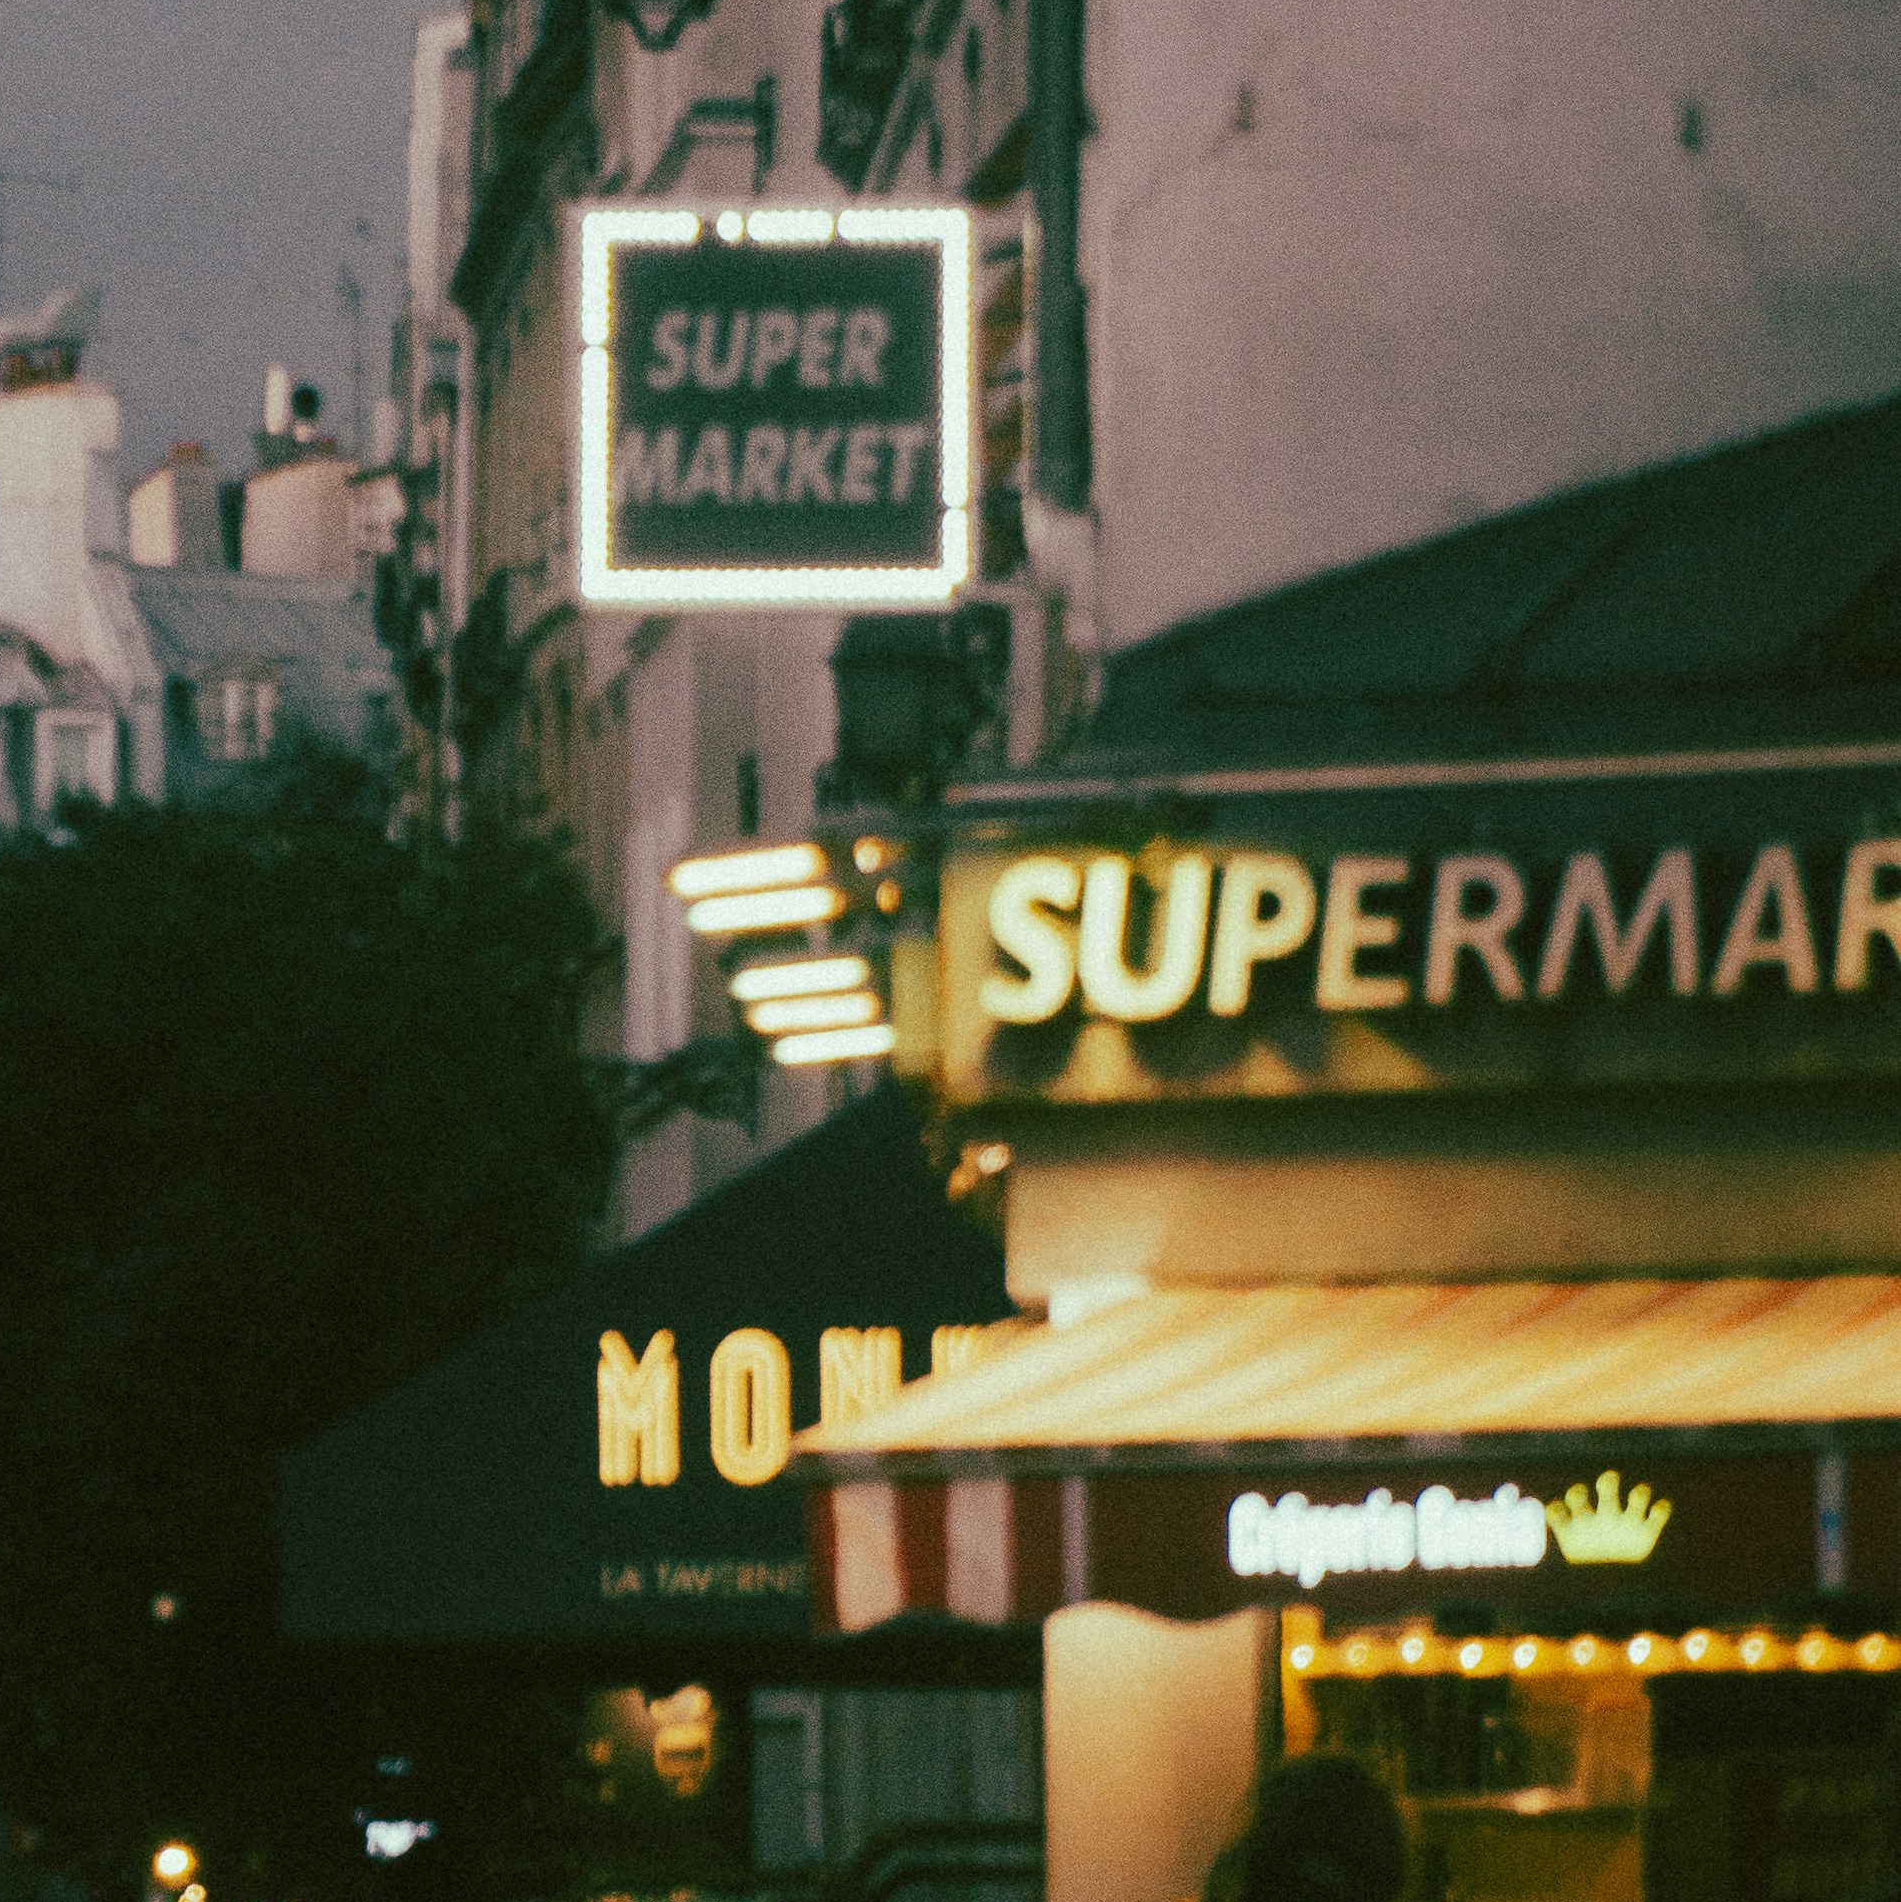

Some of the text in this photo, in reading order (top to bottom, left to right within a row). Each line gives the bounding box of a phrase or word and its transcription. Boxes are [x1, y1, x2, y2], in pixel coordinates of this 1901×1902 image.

[646, 306, 892, 392] SUPER
[612, 421, 932, 505] MARKET
[978, 837, 1901, 1024] SUPERMAR
[601, 1565, 643, 1596] LA
